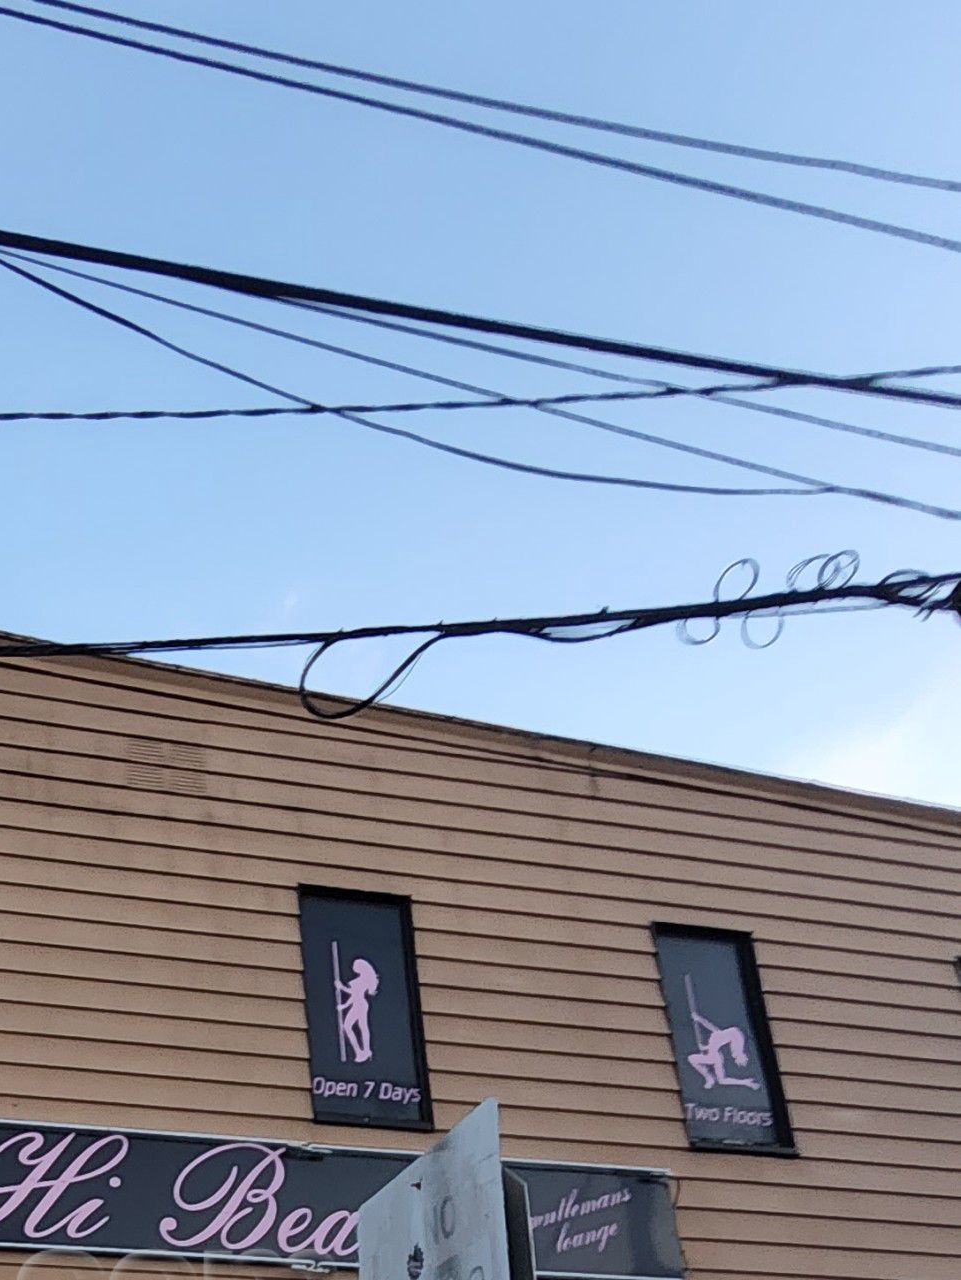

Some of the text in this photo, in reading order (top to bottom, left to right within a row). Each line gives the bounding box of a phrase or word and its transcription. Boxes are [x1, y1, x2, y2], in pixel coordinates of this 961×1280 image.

[313, 1076, 422, 1105] Open 7 Days
[684, 1102, 719, 1121] Two
[159, 1142, 361, 1256] Bea
